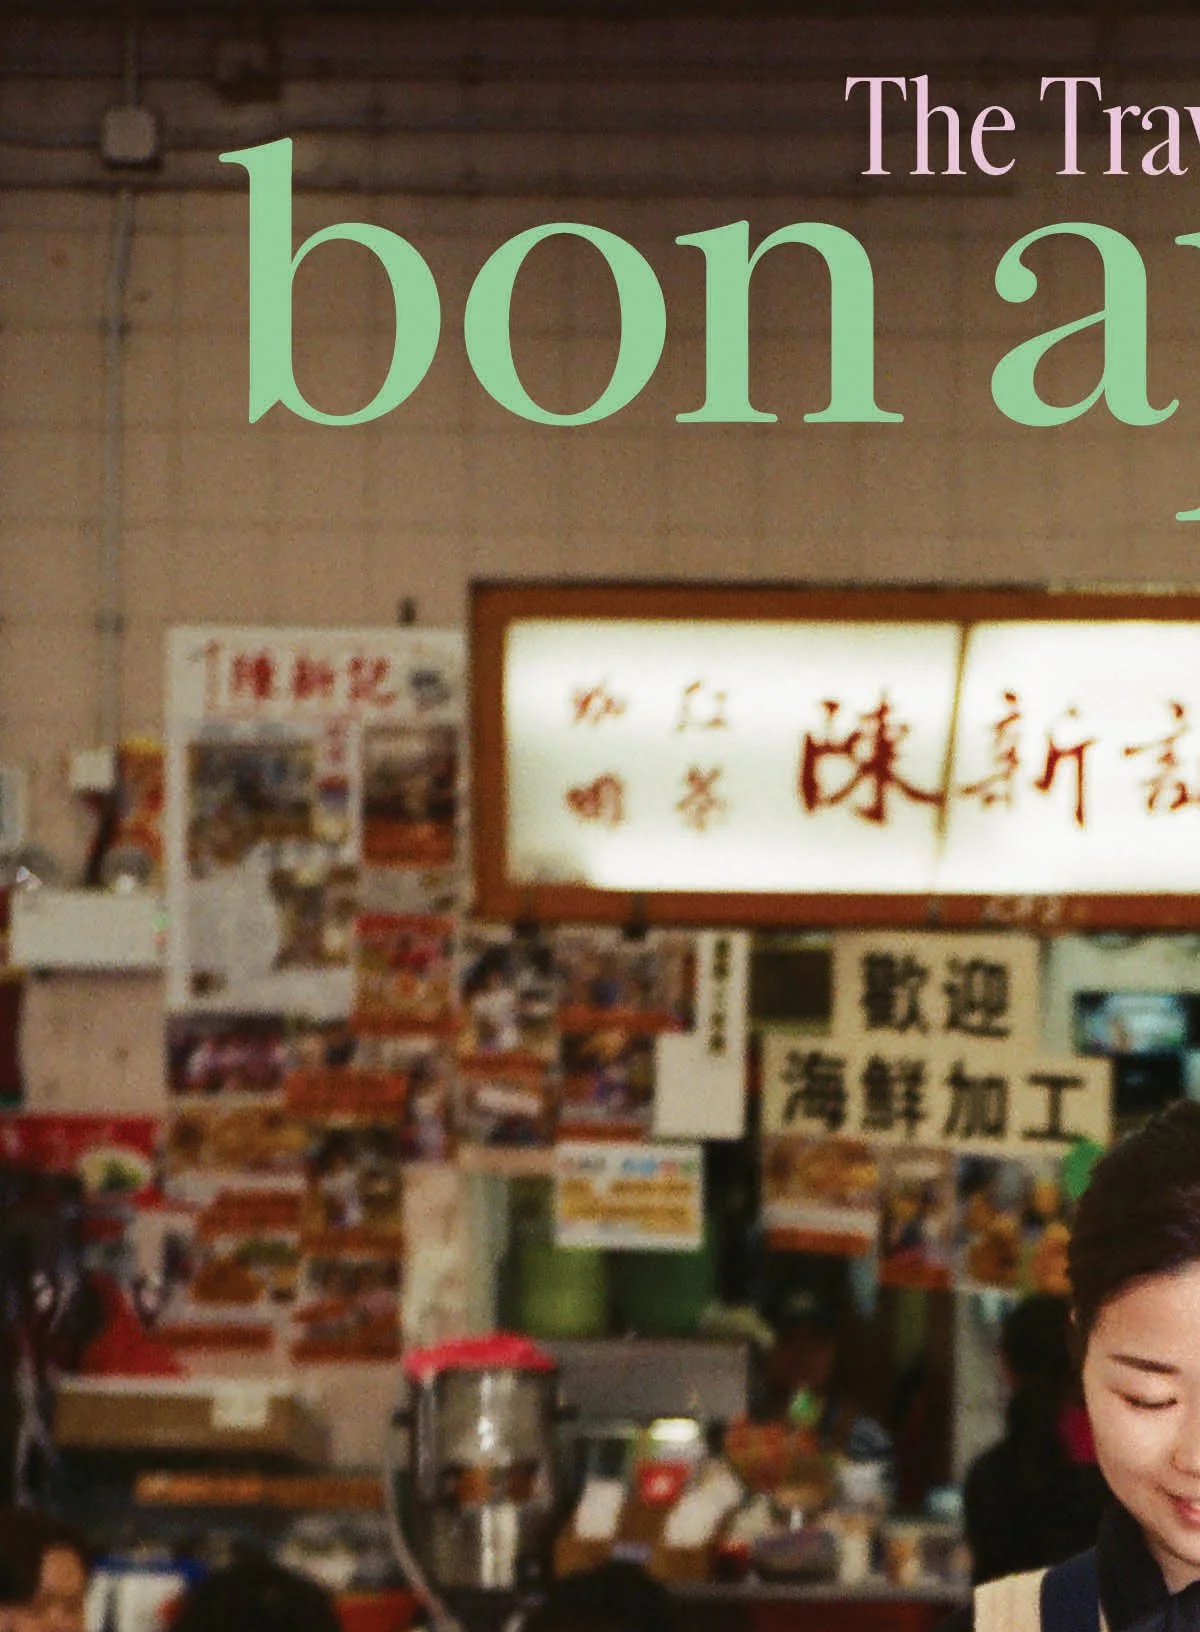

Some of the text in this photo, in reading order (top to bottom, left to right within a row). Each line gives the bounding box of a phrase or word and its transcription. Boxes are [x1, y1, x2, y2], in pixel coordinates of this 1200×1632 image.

[860, 950, 1012, 1040] 歡迎
[779, 1048, 1092, 1142] 海鮮加工
